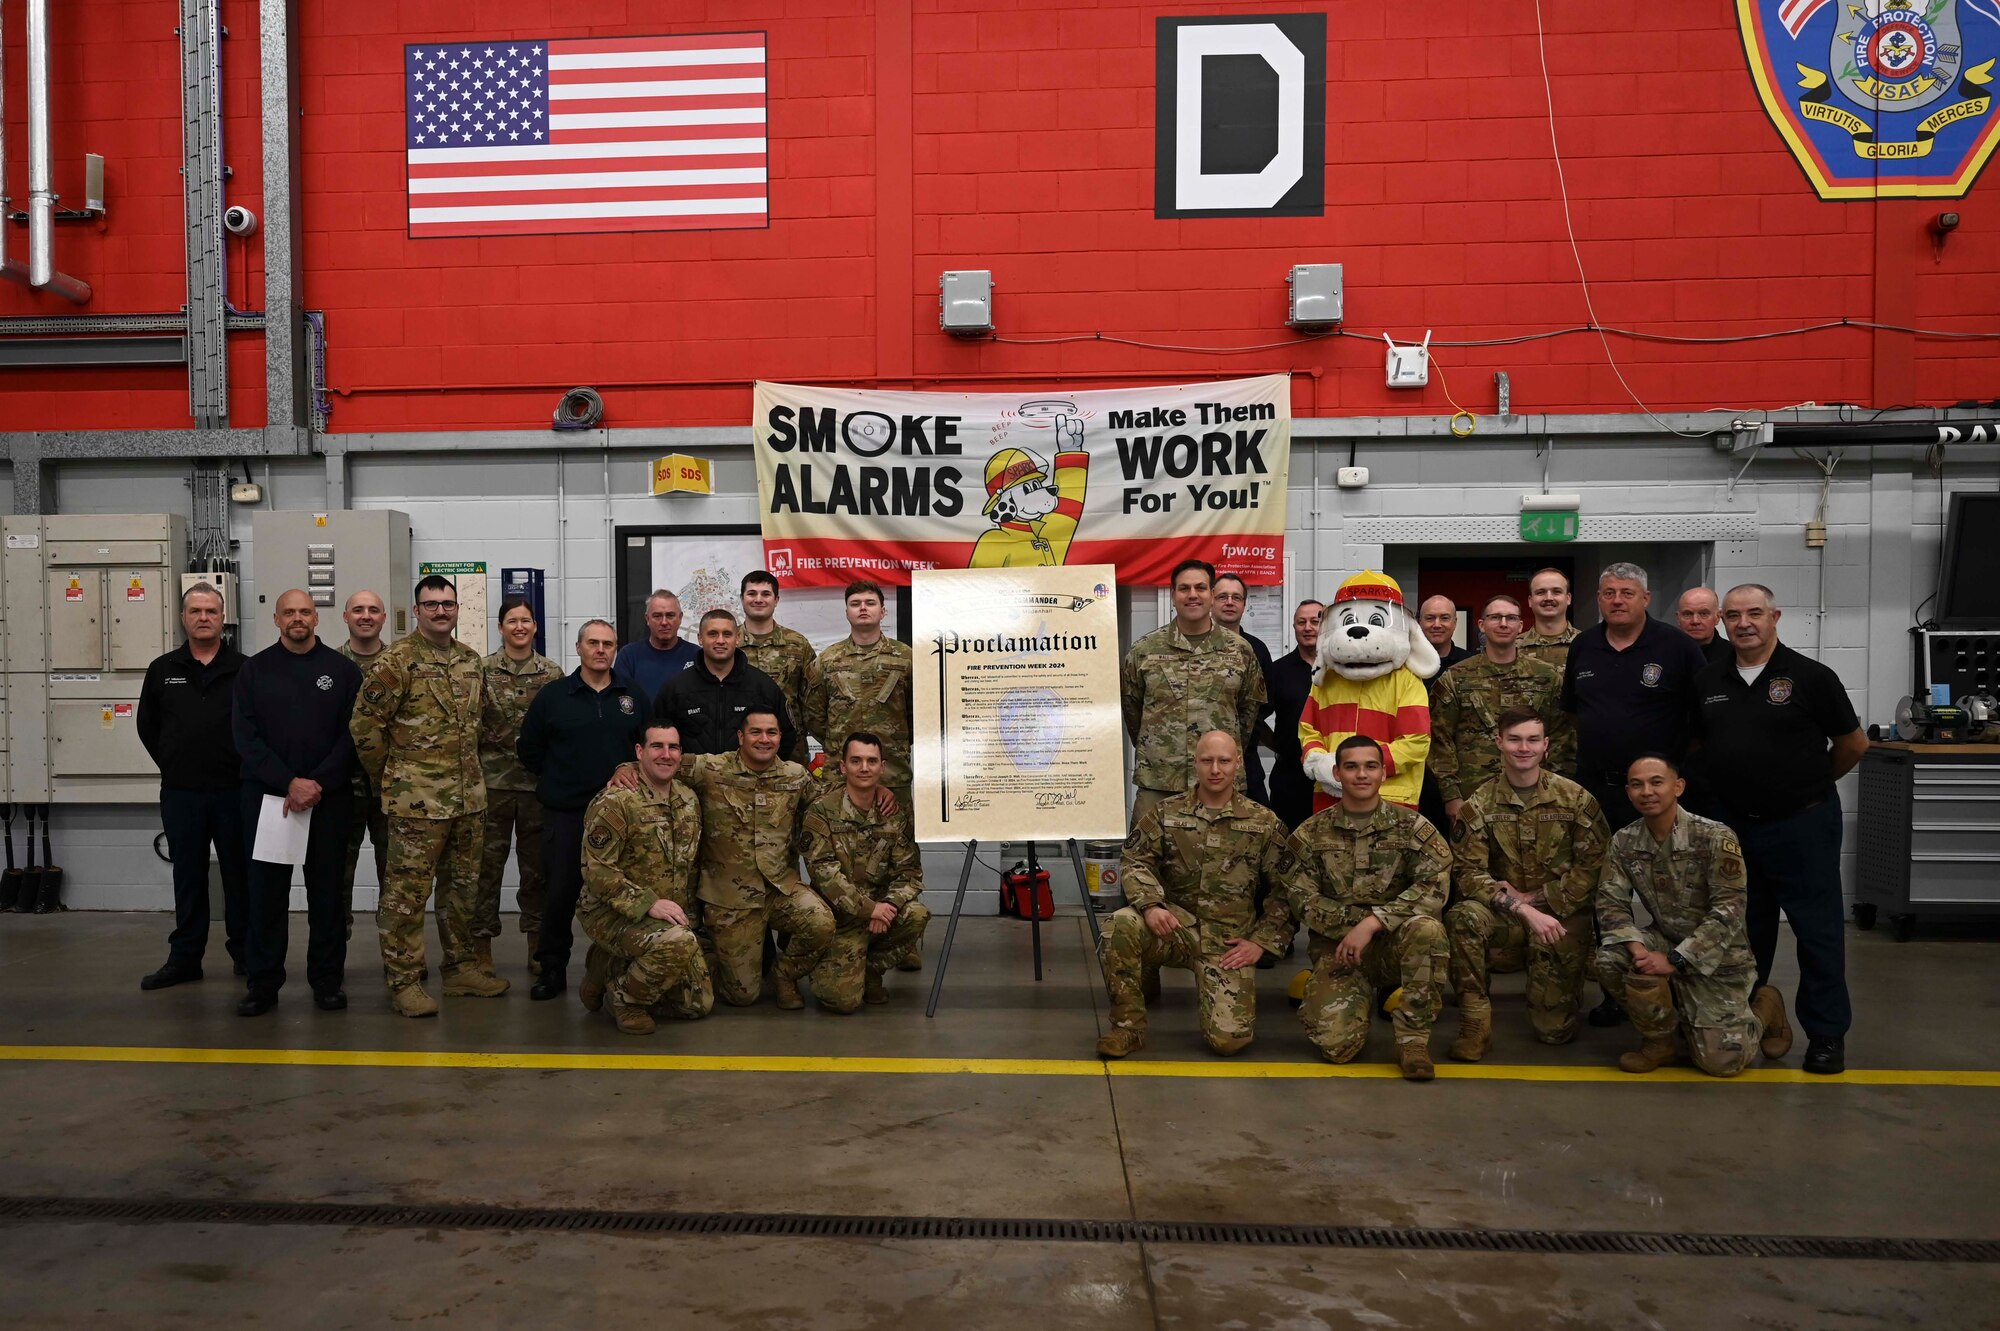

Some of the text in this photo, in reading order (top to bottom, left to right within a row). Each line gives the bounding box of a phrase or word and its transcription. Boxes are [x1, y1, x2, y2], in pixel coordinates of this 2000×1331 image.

[1881, 23, 1915, 33] DEFENCE
[1857, 11, 1936, 67] FIRE PROTECTION
[1869, 79, 1921, 99] USAF
[1175, 23, 1305, 210] D
[1804, 103, 1862, 133] VIRTUTIS
[1926, 100, 1984, 131] MERCES
[1866, 144, 1919, 157] GLORIA
[1108, 402, 1276, 430] Make Them
[766, 404, 963, 458] SMOKE
[991, 421, 1011, 433] BEEP
[989, 431, 1009, 446] BEEP
[1115, 429, 1269, 481] WORK
[657, 467, 671, 482] SDS
[680, 467, 702, 481] SDS
[770, 463, 964, 517] ALARMS
[1122, 487, 1177, 514] For
[1186, 481, 1260, 512] You!
[1221, 543, 1276, 560] fpw.org
[796, 557, 822, 569] FIRE
[824, 556, 900, 570] PREVENTION
[901, 559, 935, 571] WEEK
[1347, 586, 1389, 598] SPARKY
[930, 628, 1098, 656] Proclamation
[1417, 823, 1433, 840] FIRE
[1725, 842, 1741, 854] CE
